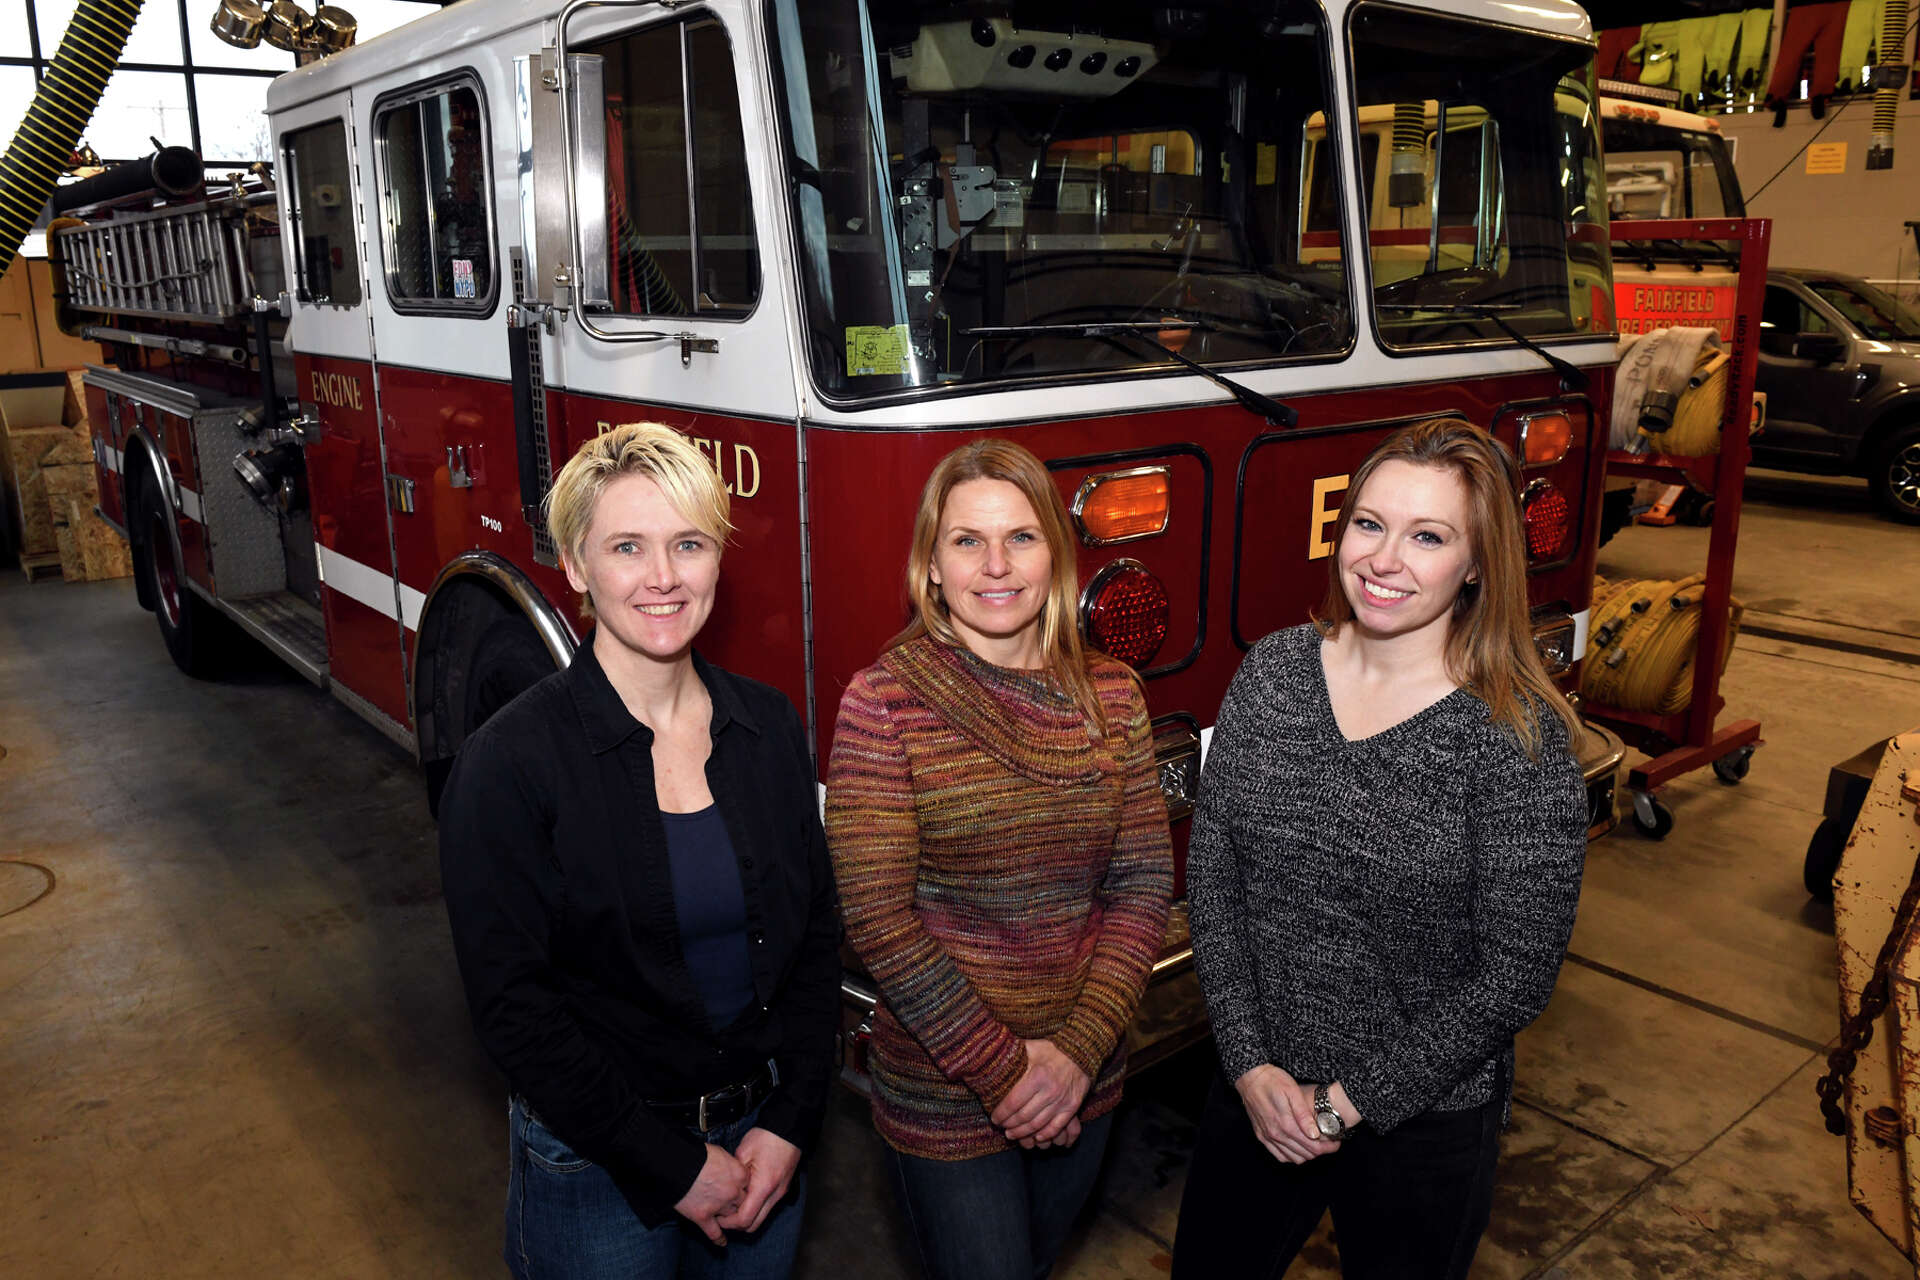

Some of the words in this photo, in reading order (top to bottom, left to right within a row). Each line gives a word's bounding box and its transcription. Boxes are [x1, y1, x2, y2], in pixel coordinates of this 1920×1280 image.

[1634, 288, 1714, 312] FAIRFIELD
[312, 371, 363, 410] ENGINE
[480, 514, 502, 533] TP100
